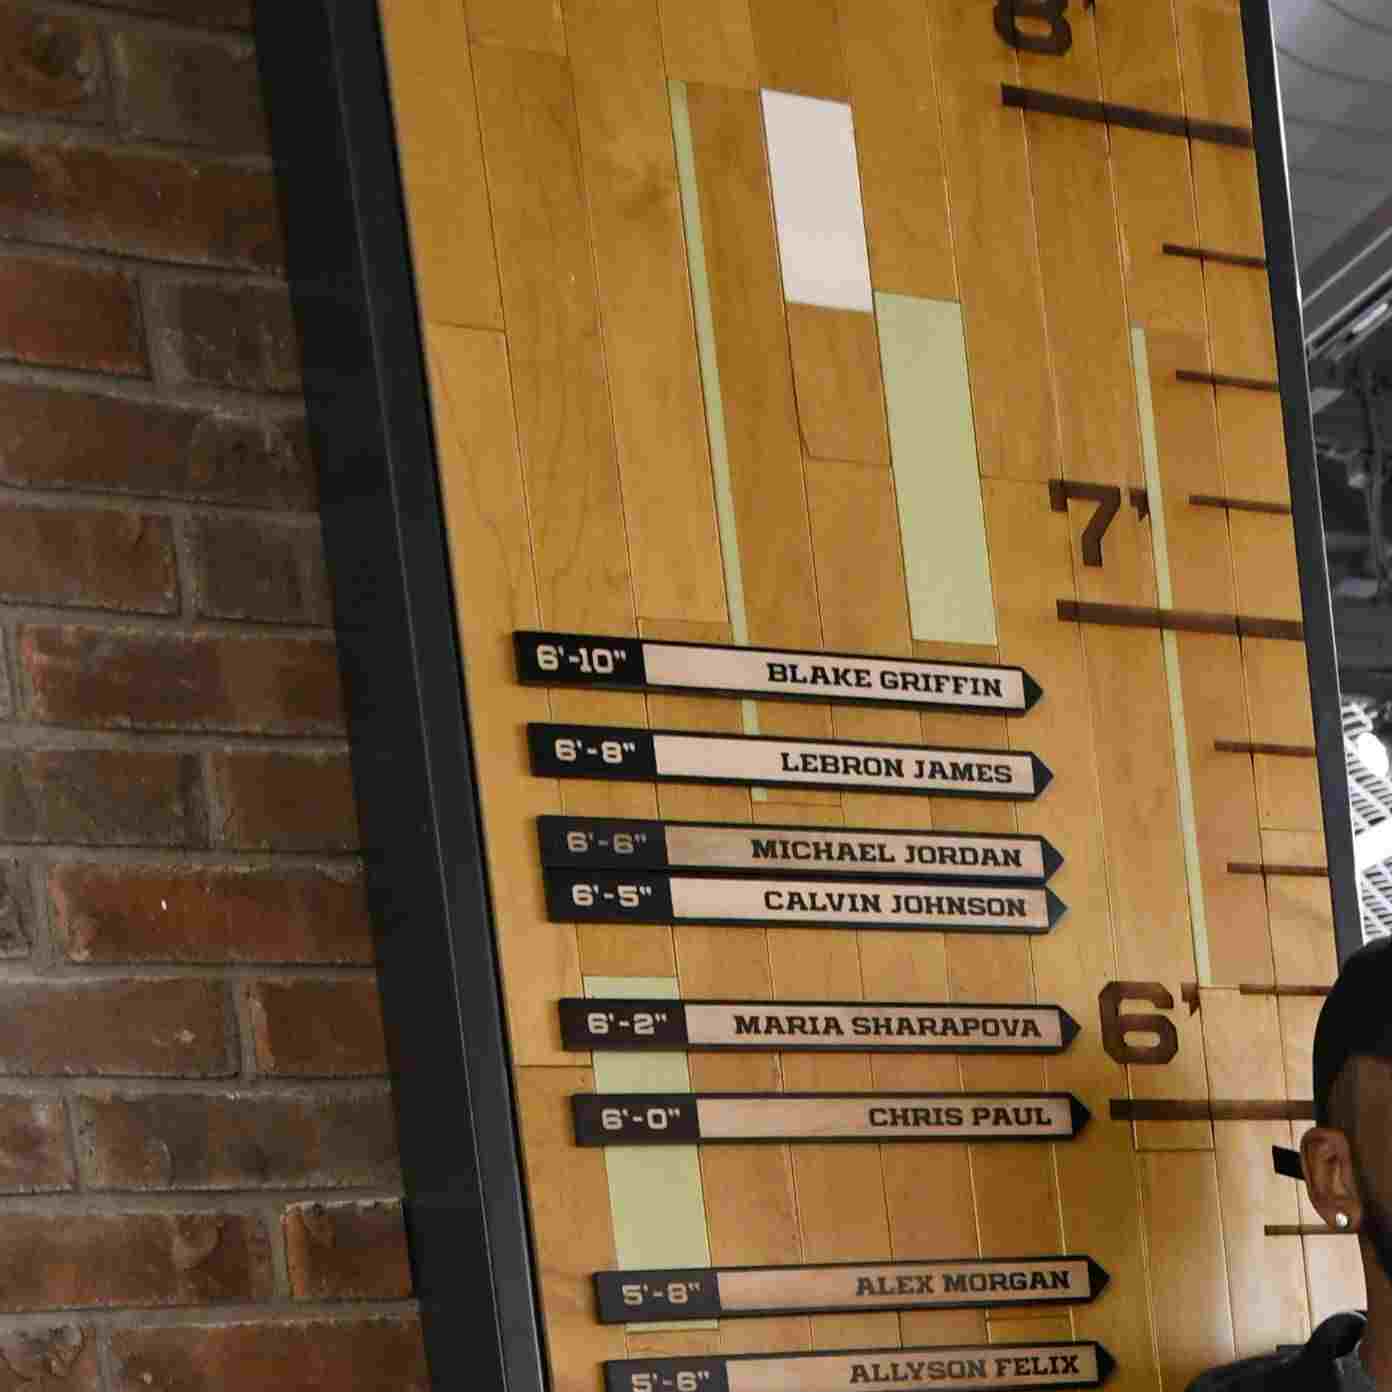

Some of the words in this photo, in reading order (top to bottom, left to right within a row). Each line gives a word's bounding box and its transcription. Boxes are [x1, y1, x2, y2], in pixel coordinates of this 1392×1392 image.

[536, 645, 627, 674] 6'-10"
[766, 660, 873, 691] BLAKE
[879, 667, 1004, 699] GRIFFIN
[553, 737, 637, 764] 6'-8"
[780, 751, 905, 779] LEBRON
[912, 757, 1014, 785] JAMES
[566, 830, 647, 855] 6'-6"
[750, 838, 896, 865] MICHAEL
[904, 842, 1023, 868] JORDAN
[571, 883, 653, 909] 6'-5"
[763, 889, 883, 915] CALVIN
[890, 892, 1028, 918] JOHNSON
[586, 1011, 668, 1037] 6'-2"
[733, 1014, 845, 1037] MARIA
[851, 1014, 1043, 1039] SHARAPOVA
[601, 1106, 681, 1131] 6'-0"
[868, 1105, 966, 1128] CHRIS
[971, 1104, 1053, 1127] PAUL
[854, 1272, 936, 1298] ALEX
[942, 1268, 1072, 1295] MORGAN
[849, 1357, 988, 1385] ALLYSON
[994, 1354, 1081, 1379] FELIX
